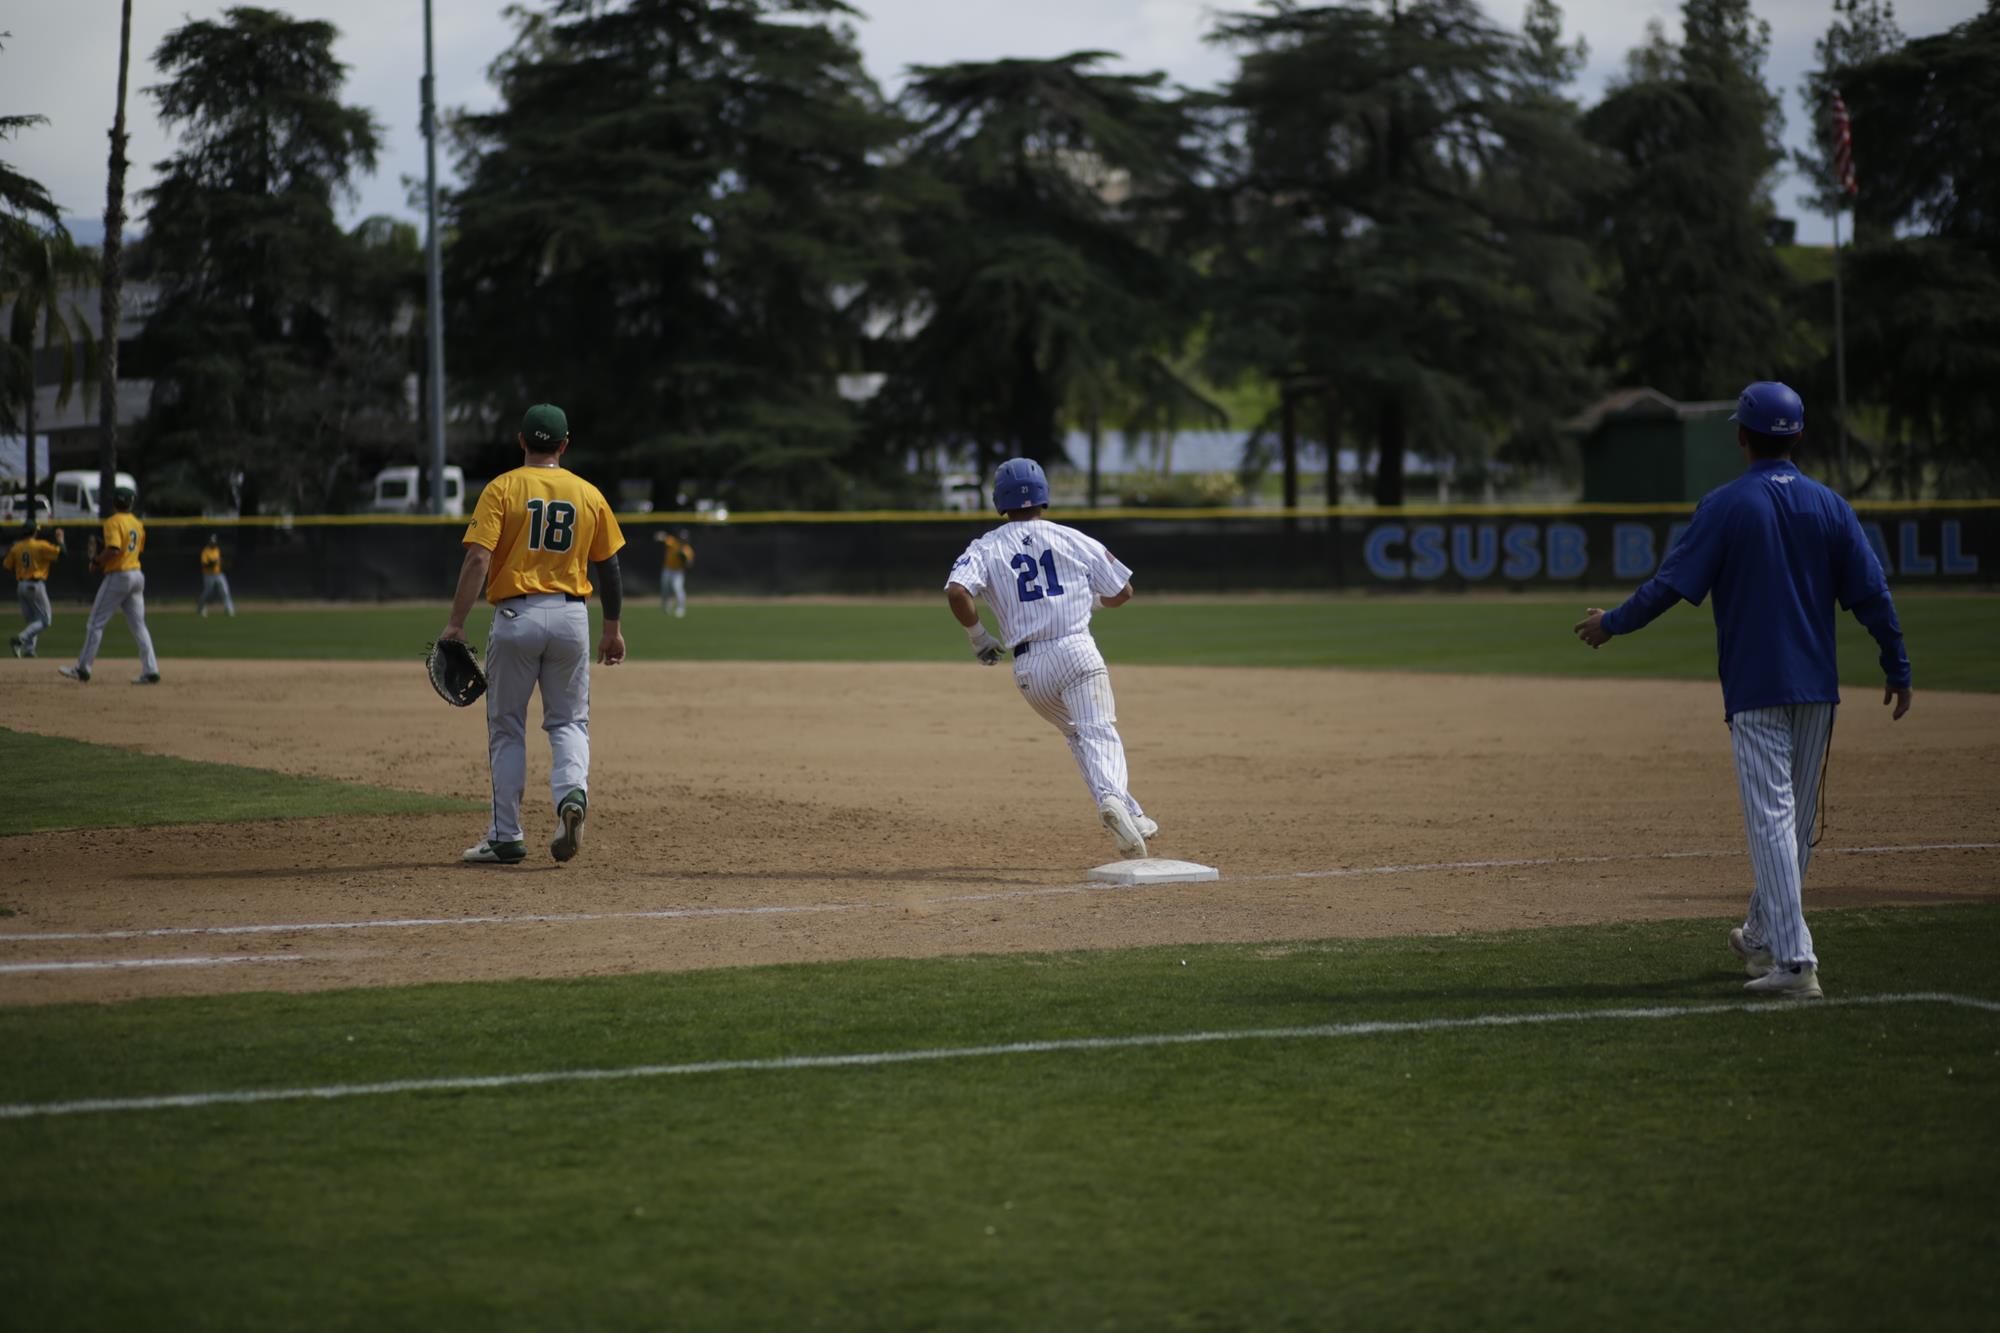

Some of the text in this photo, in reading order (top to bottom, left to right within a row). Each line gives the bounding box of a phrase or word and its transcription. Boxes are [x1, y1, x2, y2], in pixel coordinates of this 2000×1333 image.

[127, 529, 137, 552] 3
[527, 498, 577, 553] 18
[1363, 523, 1589, 580] CSUSB
[1010, 549, 1064, 602] 21
